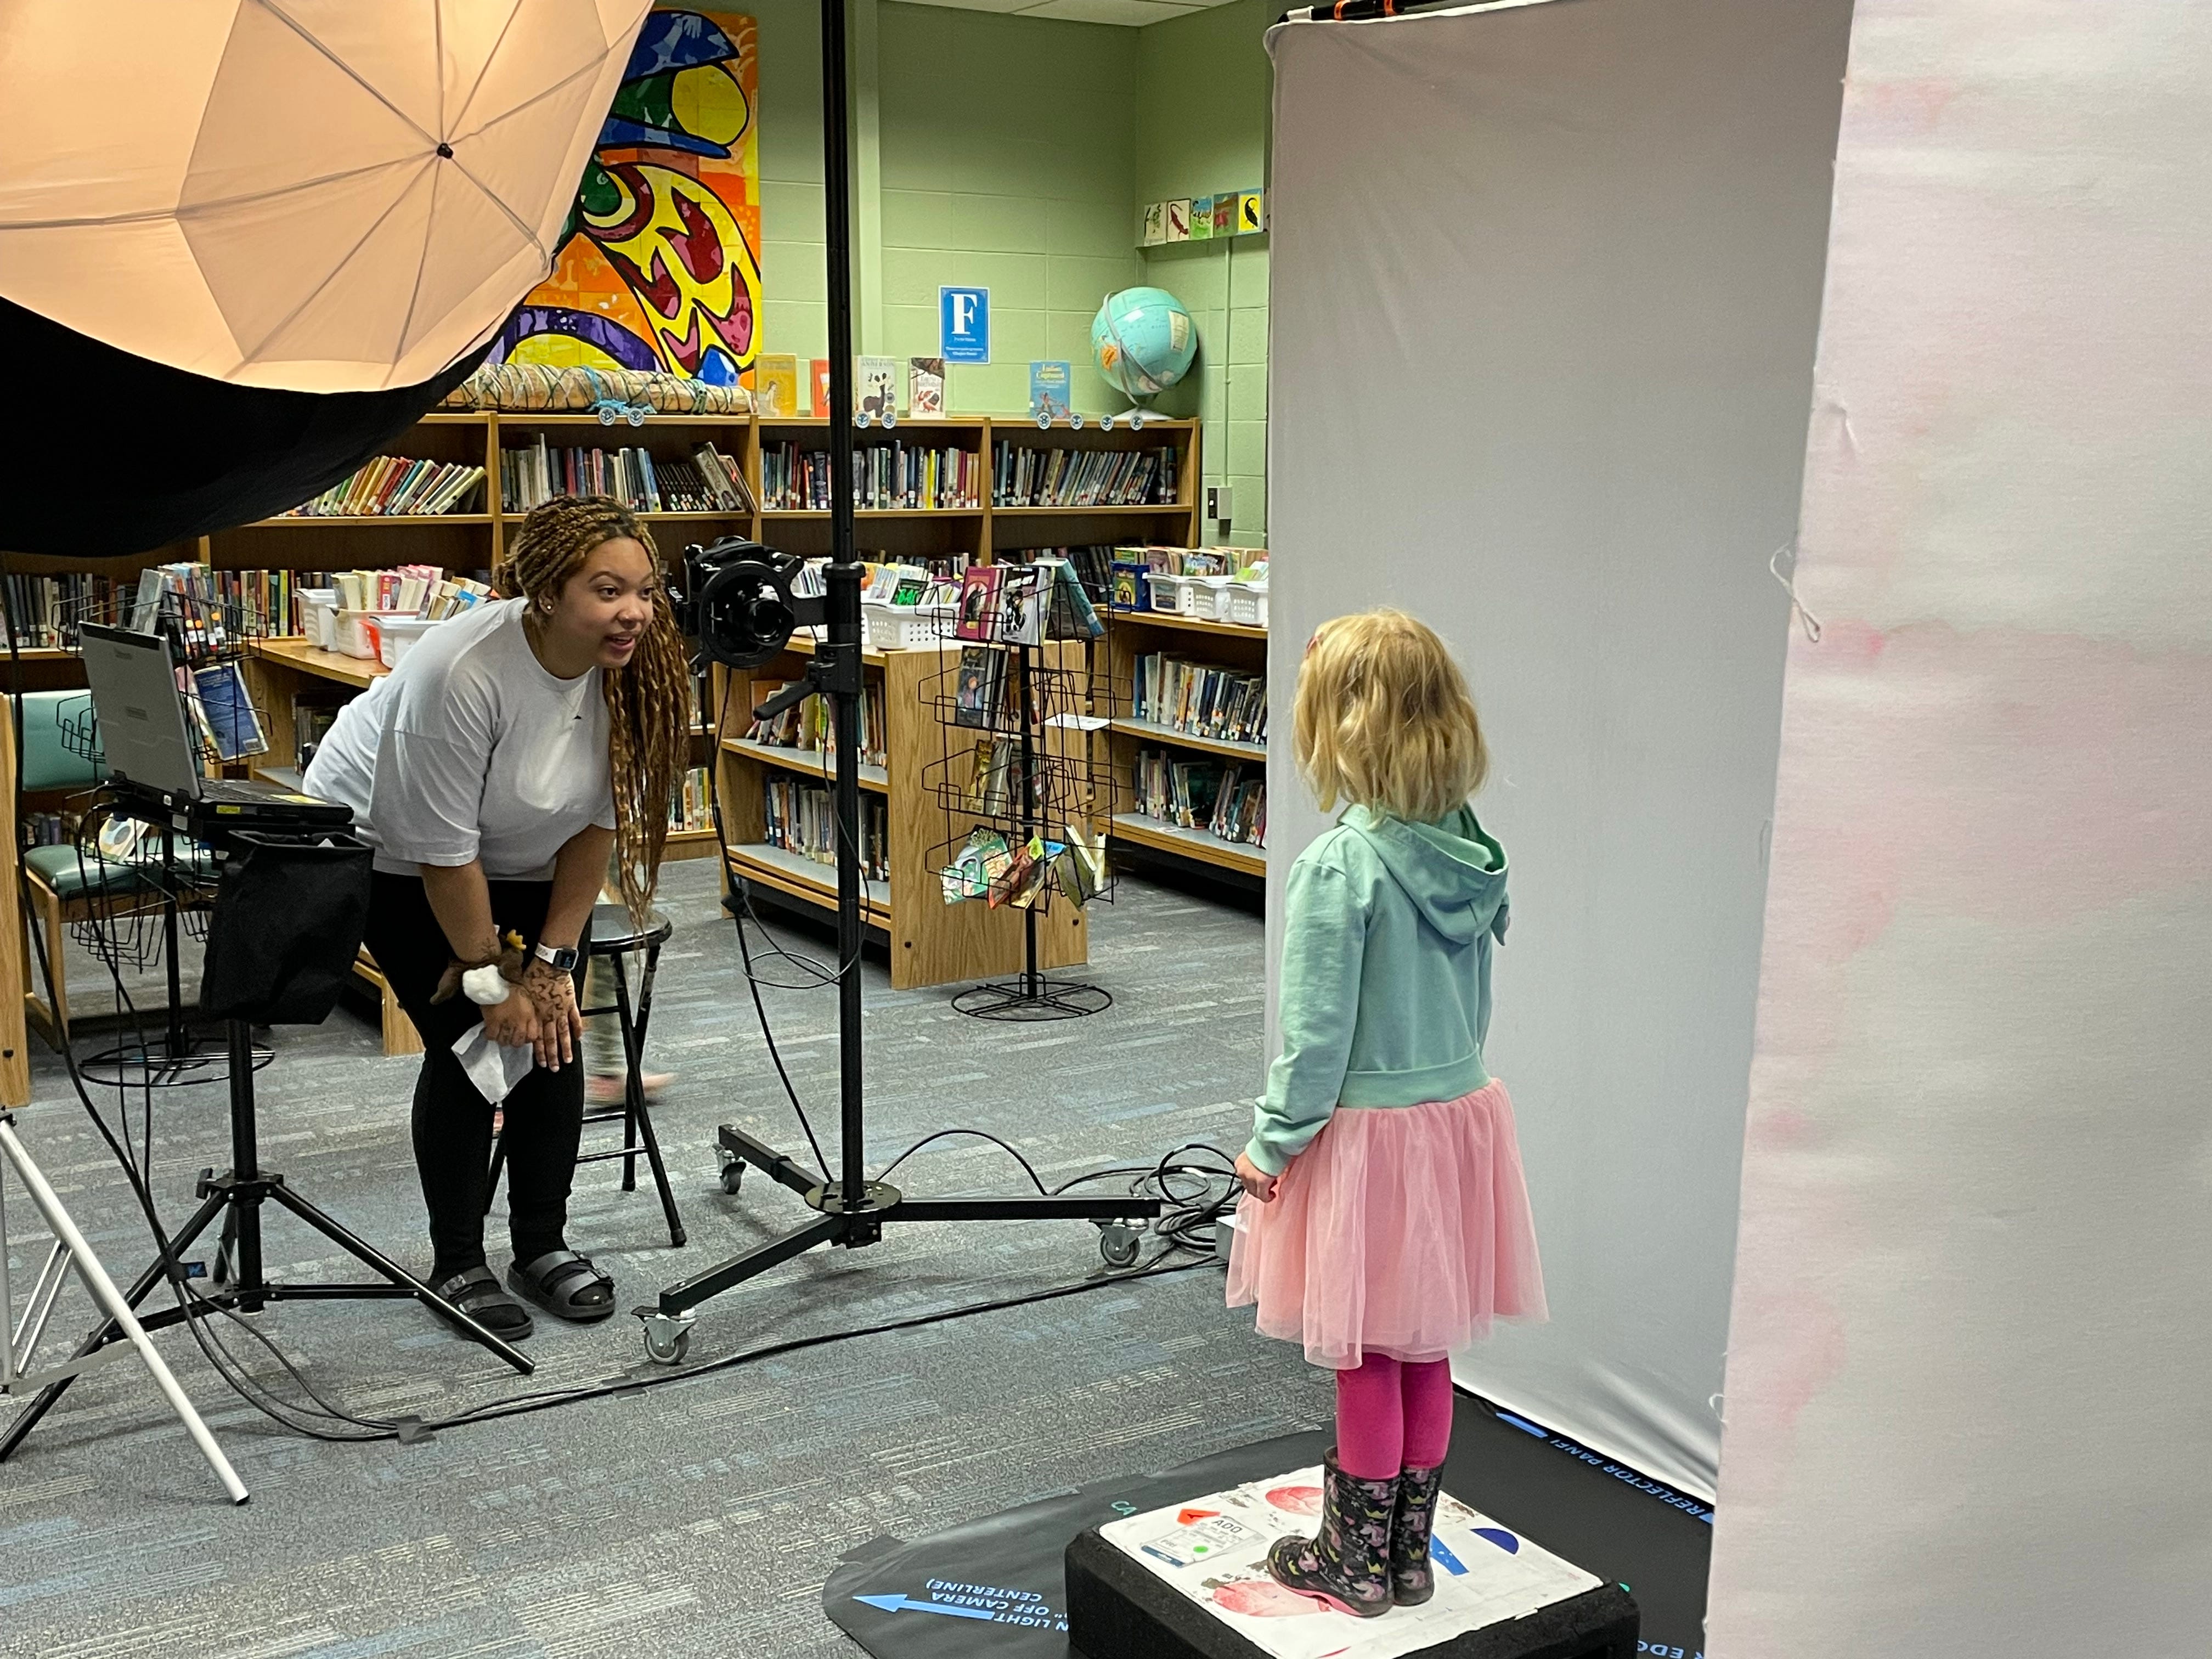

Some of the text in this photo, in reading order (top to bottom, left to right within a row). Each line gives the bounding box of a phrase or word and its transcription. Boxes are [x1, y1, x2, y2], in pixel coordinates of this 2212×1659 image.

[951, 294, 978, 335] F
[1603, 1464, 1706, 1515] REFLECTOR
[926, 1578, 1043, 1602] CENTERLINE)
[932, 1592, 1008, 1610] CAMERA
[1013, 1605, 1049, 1616] OFF
[994, 1612, 1051, 1628] LIGHT
